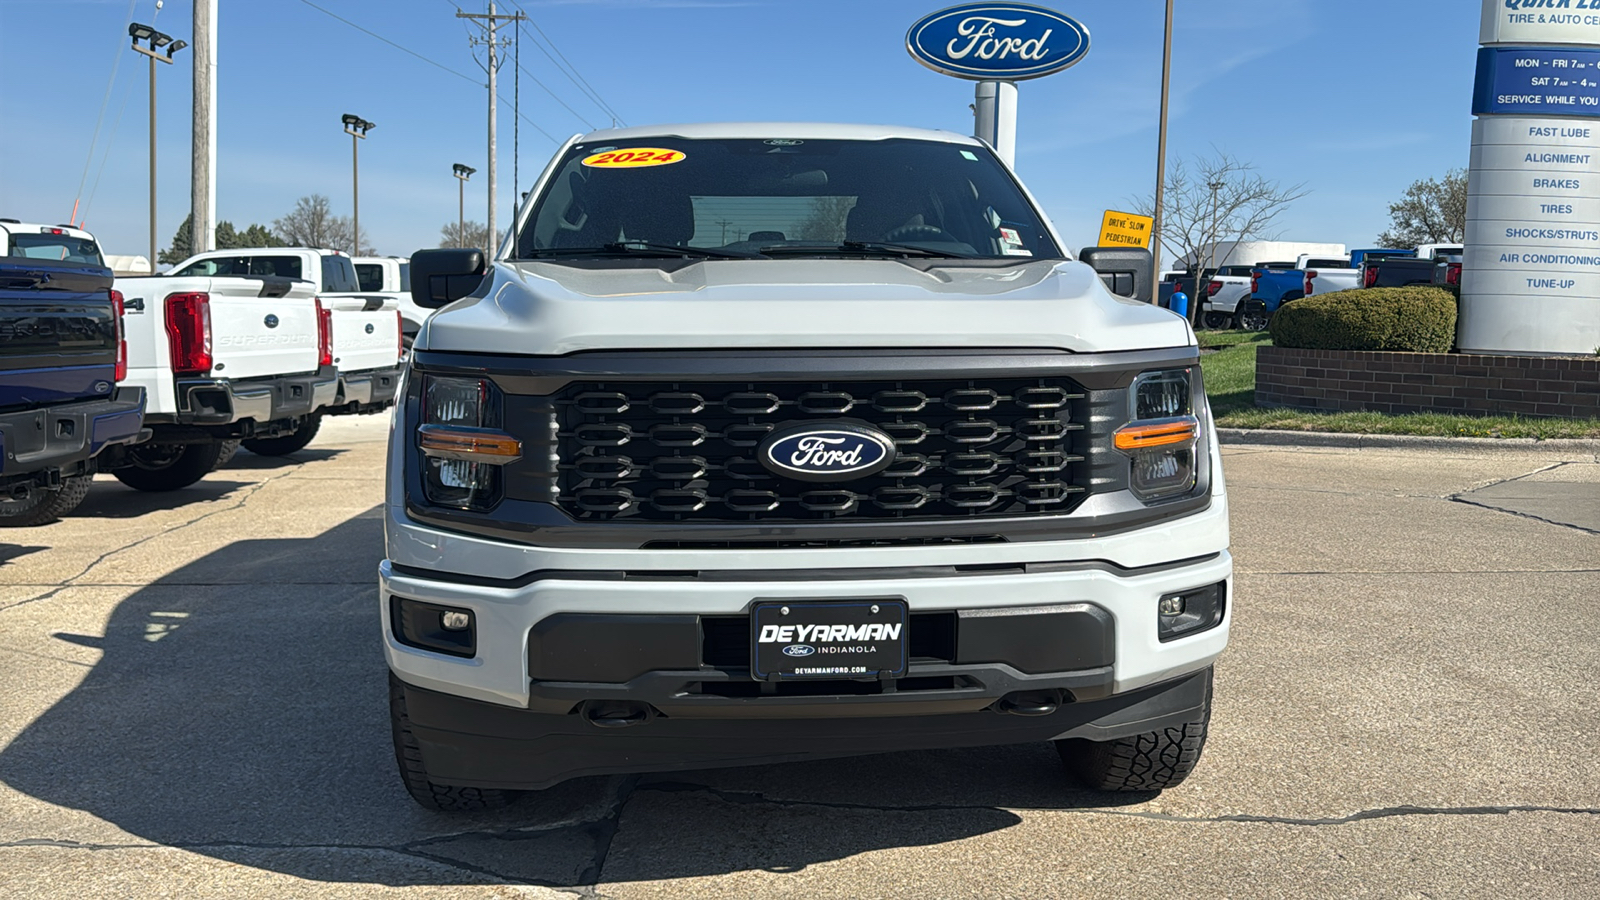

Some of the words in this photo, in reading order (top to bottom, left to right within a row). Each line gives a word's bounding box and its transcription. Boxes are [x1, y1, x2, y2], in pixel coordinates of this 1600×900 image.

[1508, 14, 1535, 23] TIRE
[1538, 14, 1546, 23] &
[1549, 14, 1581, 24] AUTO
[1584, 15, 1600, 25] CE
[947, 16, 1052, 60] Ford
[1515, 59, 1540, 68] MON
[1552, 59, 1568, 68] FRI
[1531, 77, 1550, 86] SAT
[1497, 94, 1542, 104] SERVICE
[1545, 95, 1576, 104] WHILE
[1579, 96, 1598, 105] YOU
[1529, 127, 1558, 136] FAST
[1561, 128, 1590, 138] LUBE
[590, 152, 677, 165] 2024
[1524, 153, 1590, 164] ALIGNMENT
[1533, 178, 1580, 189] BRAKES
[1540, 204, 1573, 214] TIRES
[1108, 218, 1127, 228] DRIVE
[1129, 221, 1146, 231] SLOW
[1105, 232, 1142, 245] PEDESTRIAN
[1505, 228, 1599, 241] SHOCKS/STRUTS
[1499, 253, 1519, 263] AIR
[1522, 253, 1600, 266] CONDITIONING
[1526, 278, 1575, 289] TUNE-UP
[219, 334, 278, 347] SUPER
[791, 436, 863, 466] Ford
[758, 623, 902, 643] DEYARMAN
[818, 646, 877, 654] INDIANOLA
[795, 666, 866, 675] DEYARMANFORD.COM
